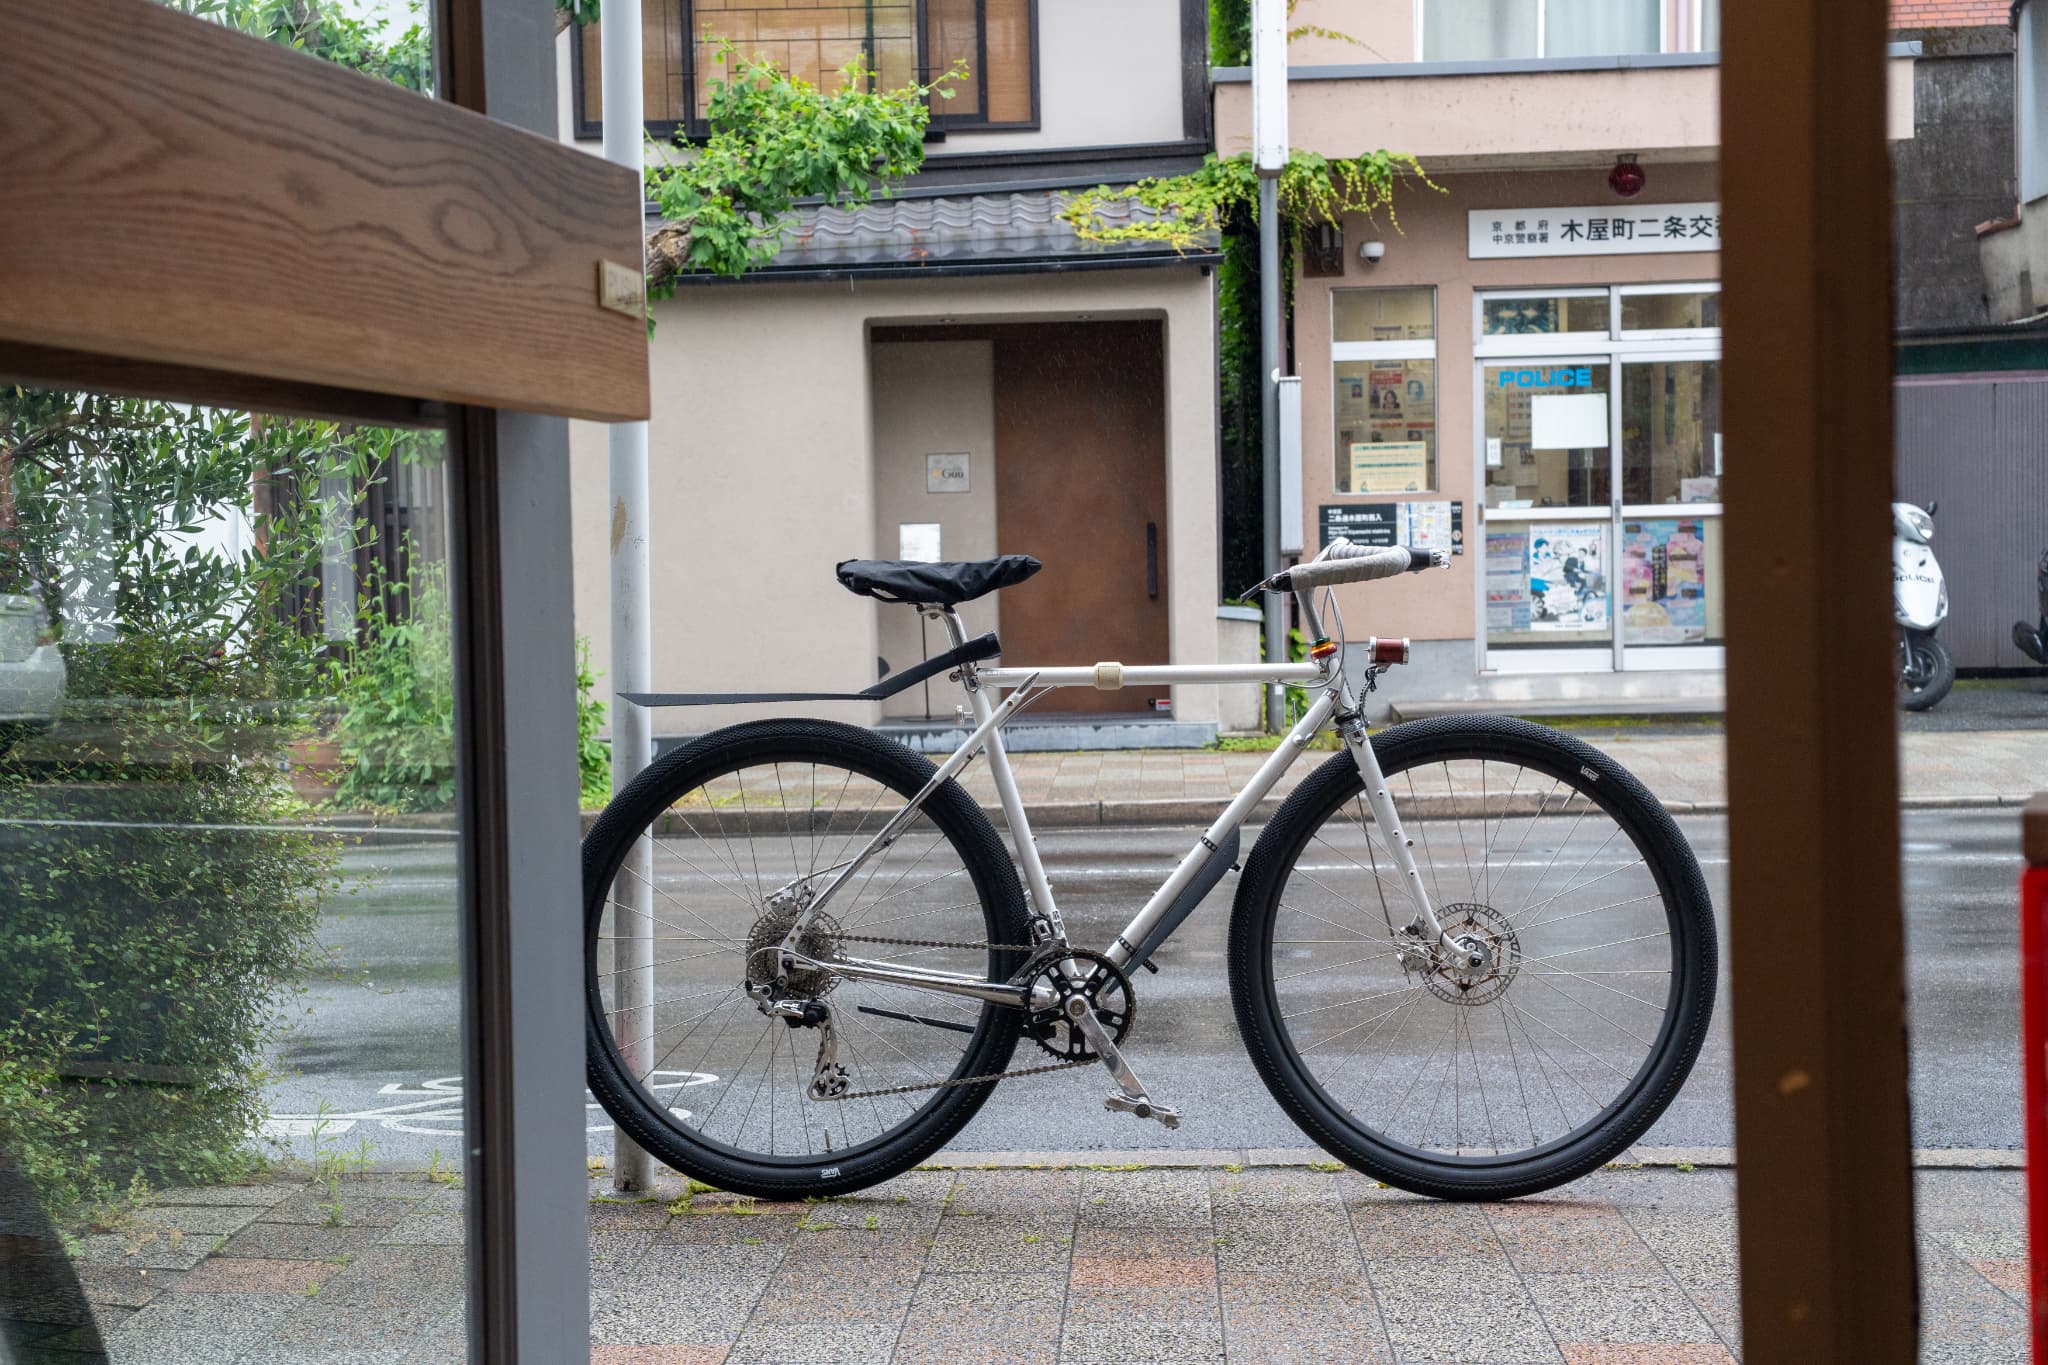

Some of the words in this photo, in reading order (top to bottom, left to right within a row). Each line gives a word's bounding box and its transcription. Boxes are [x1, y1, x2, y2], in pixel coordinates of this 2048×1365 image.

[1491, 219, 1549, 232] 京都府
[1560, 214, 1721, 242] 木屋町二条交
[1498, 367, 1592, 388] POLICE
